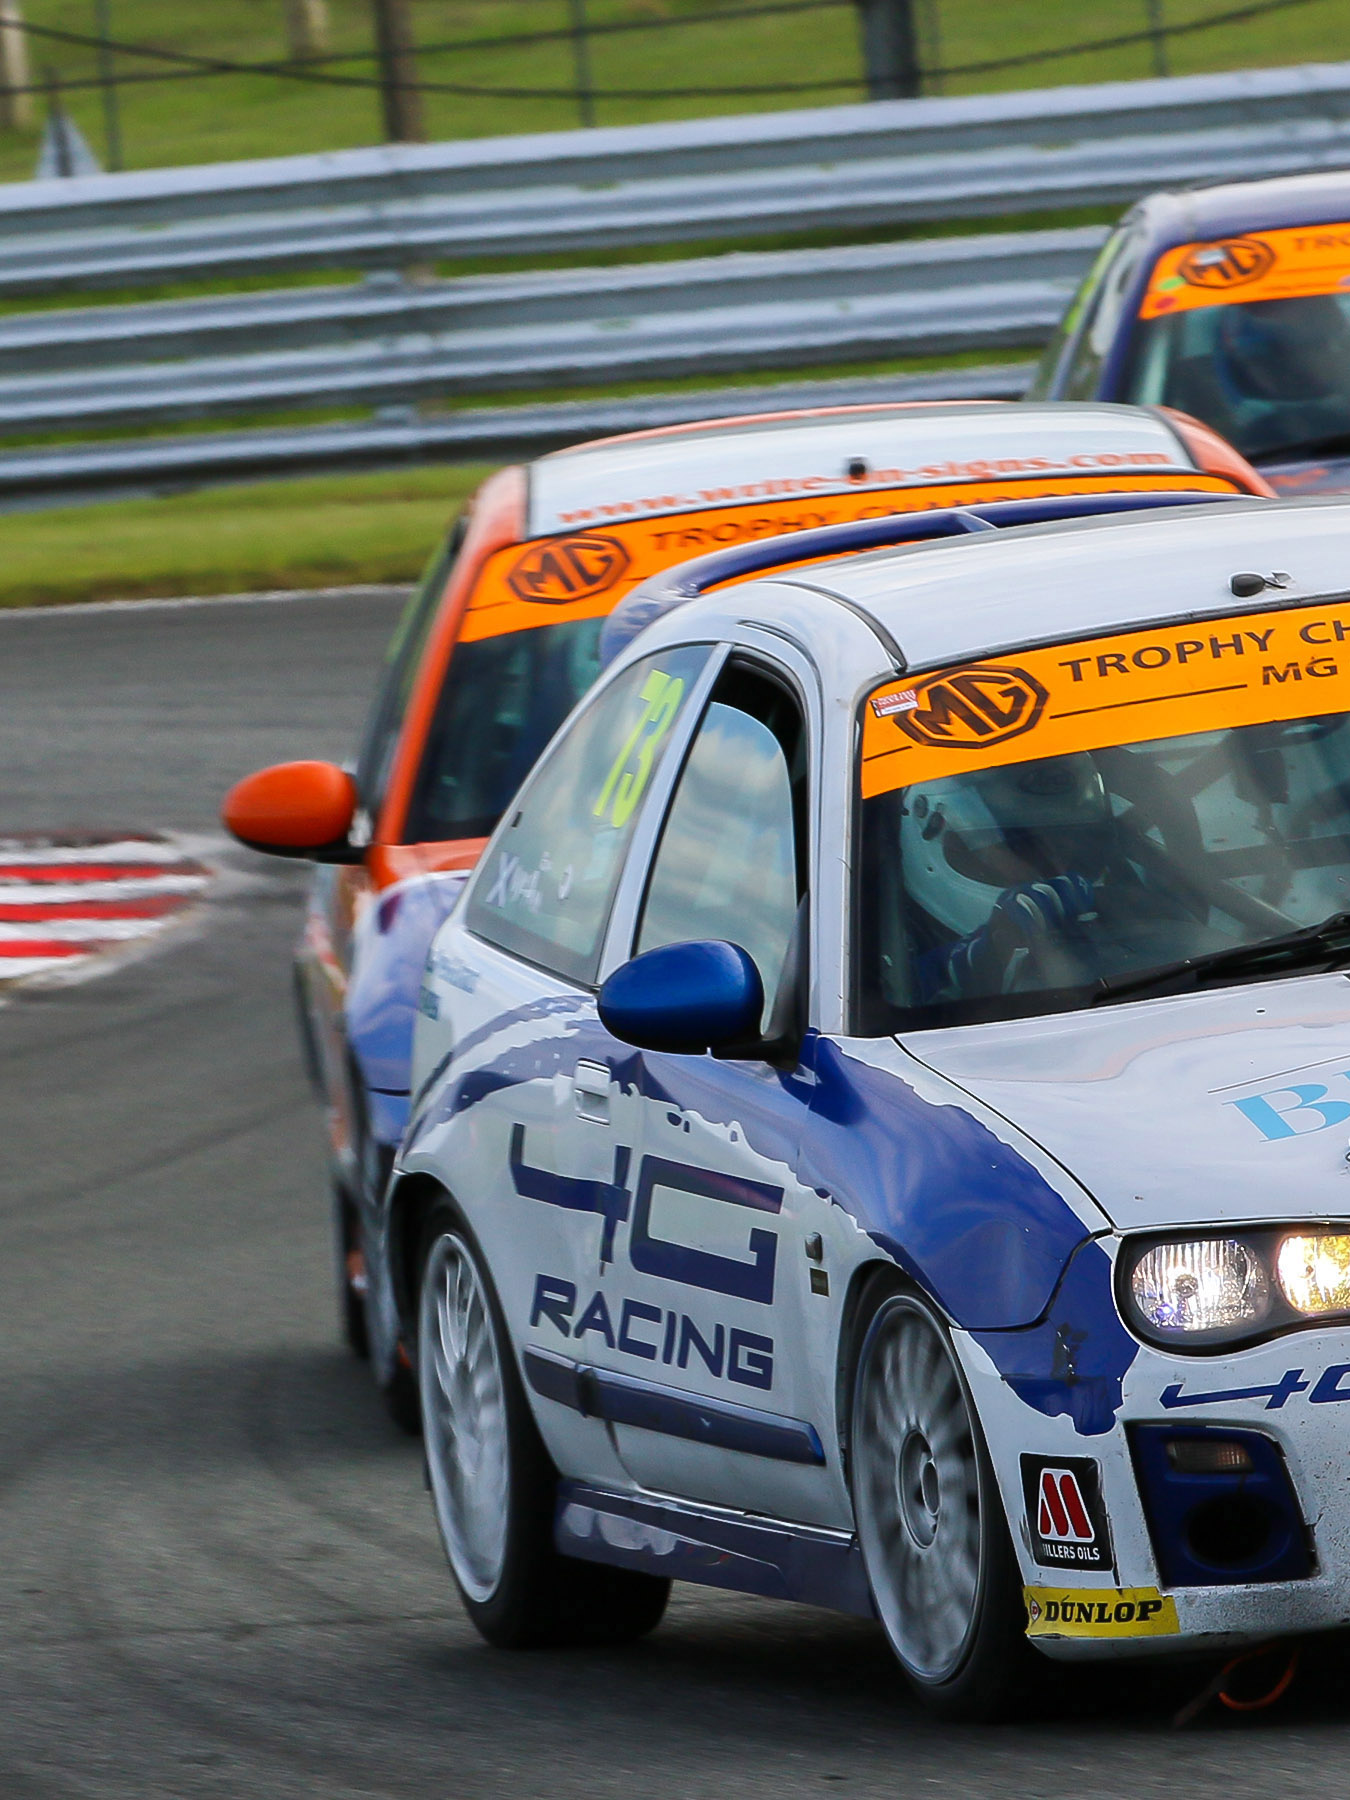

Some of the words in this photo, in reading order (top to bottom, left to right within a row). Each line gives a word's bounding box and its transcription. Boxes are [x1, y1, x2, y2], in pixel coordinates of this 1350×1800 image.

[1059, 628, 1275, 682] TROPHY
[1262, 656, 1338, 686] MG
[592, 668, 685, 829] 73
[508, 1121, 785, 1306] 4G
[529, 1272, 774, 1392] RACING
[1044, 1599, 1163, 1624] DUNLOP
